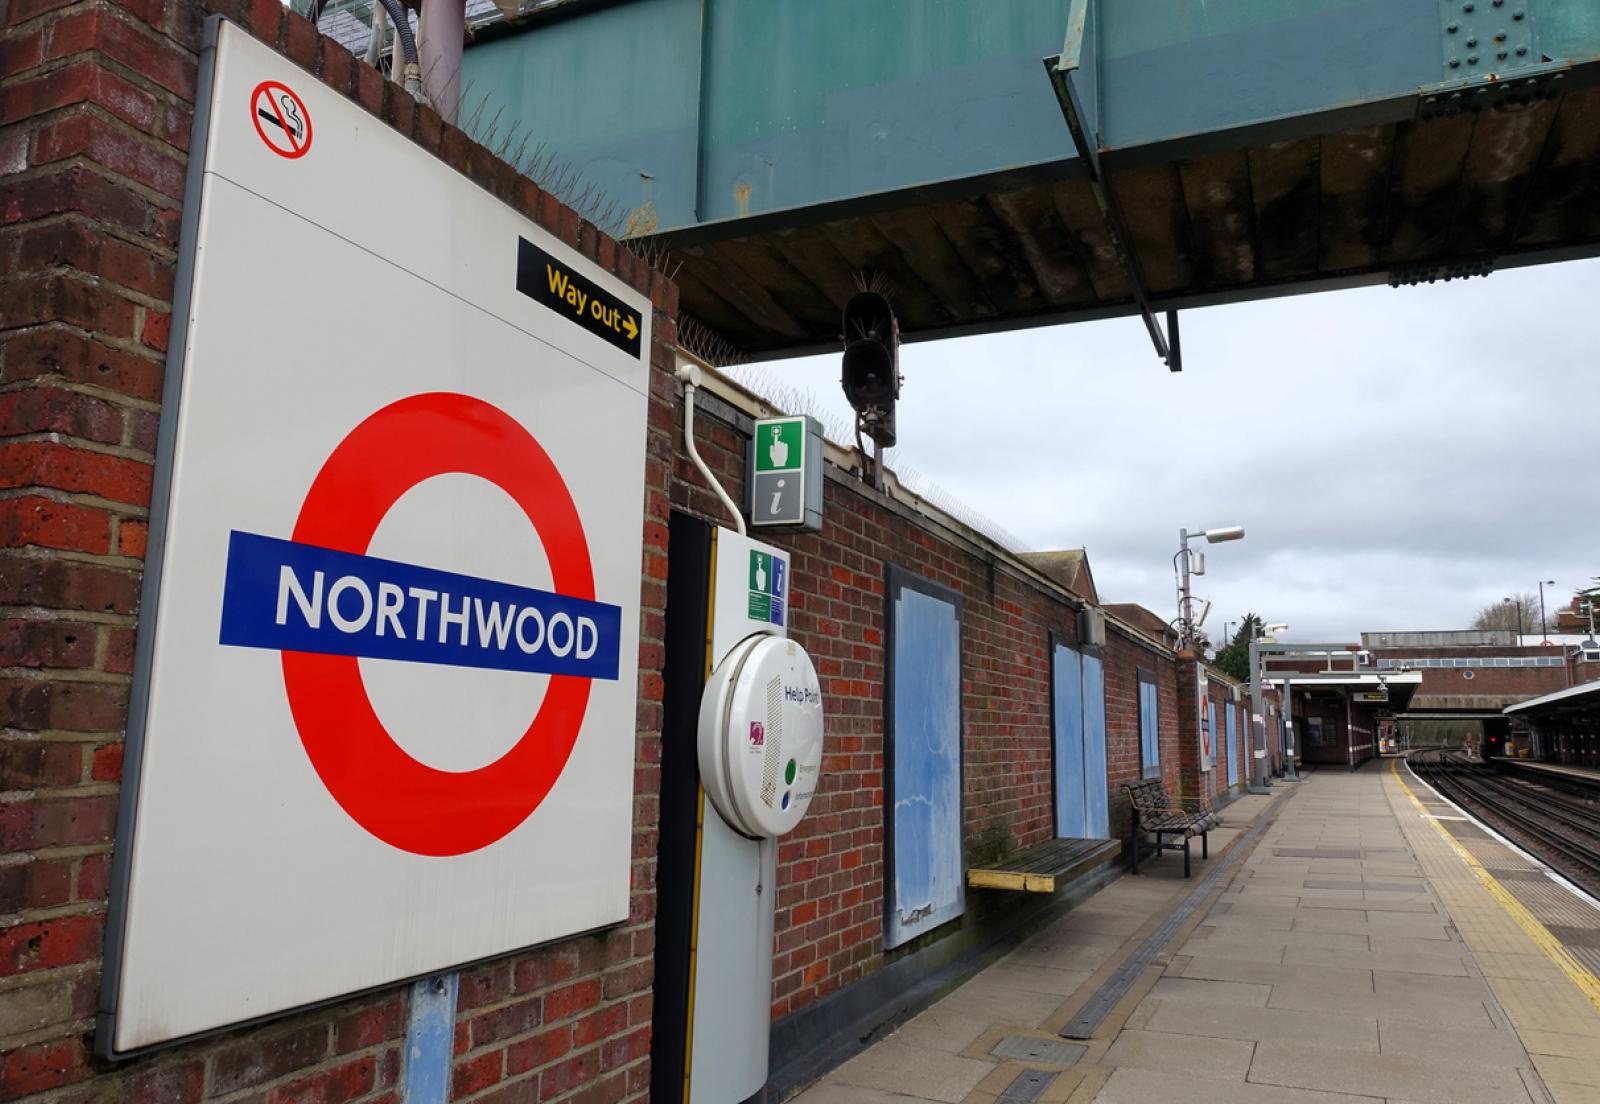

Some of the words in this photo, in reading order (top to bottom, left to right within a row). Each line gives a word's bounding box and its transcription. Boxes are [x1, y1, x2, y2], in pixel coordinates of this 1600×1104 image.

[546, 263, 587, 316] Way
[590, 300, 621, 333] out
[275, 564, 599, 660] NORTHWOOD
[784, 685, 804, 705] Help
